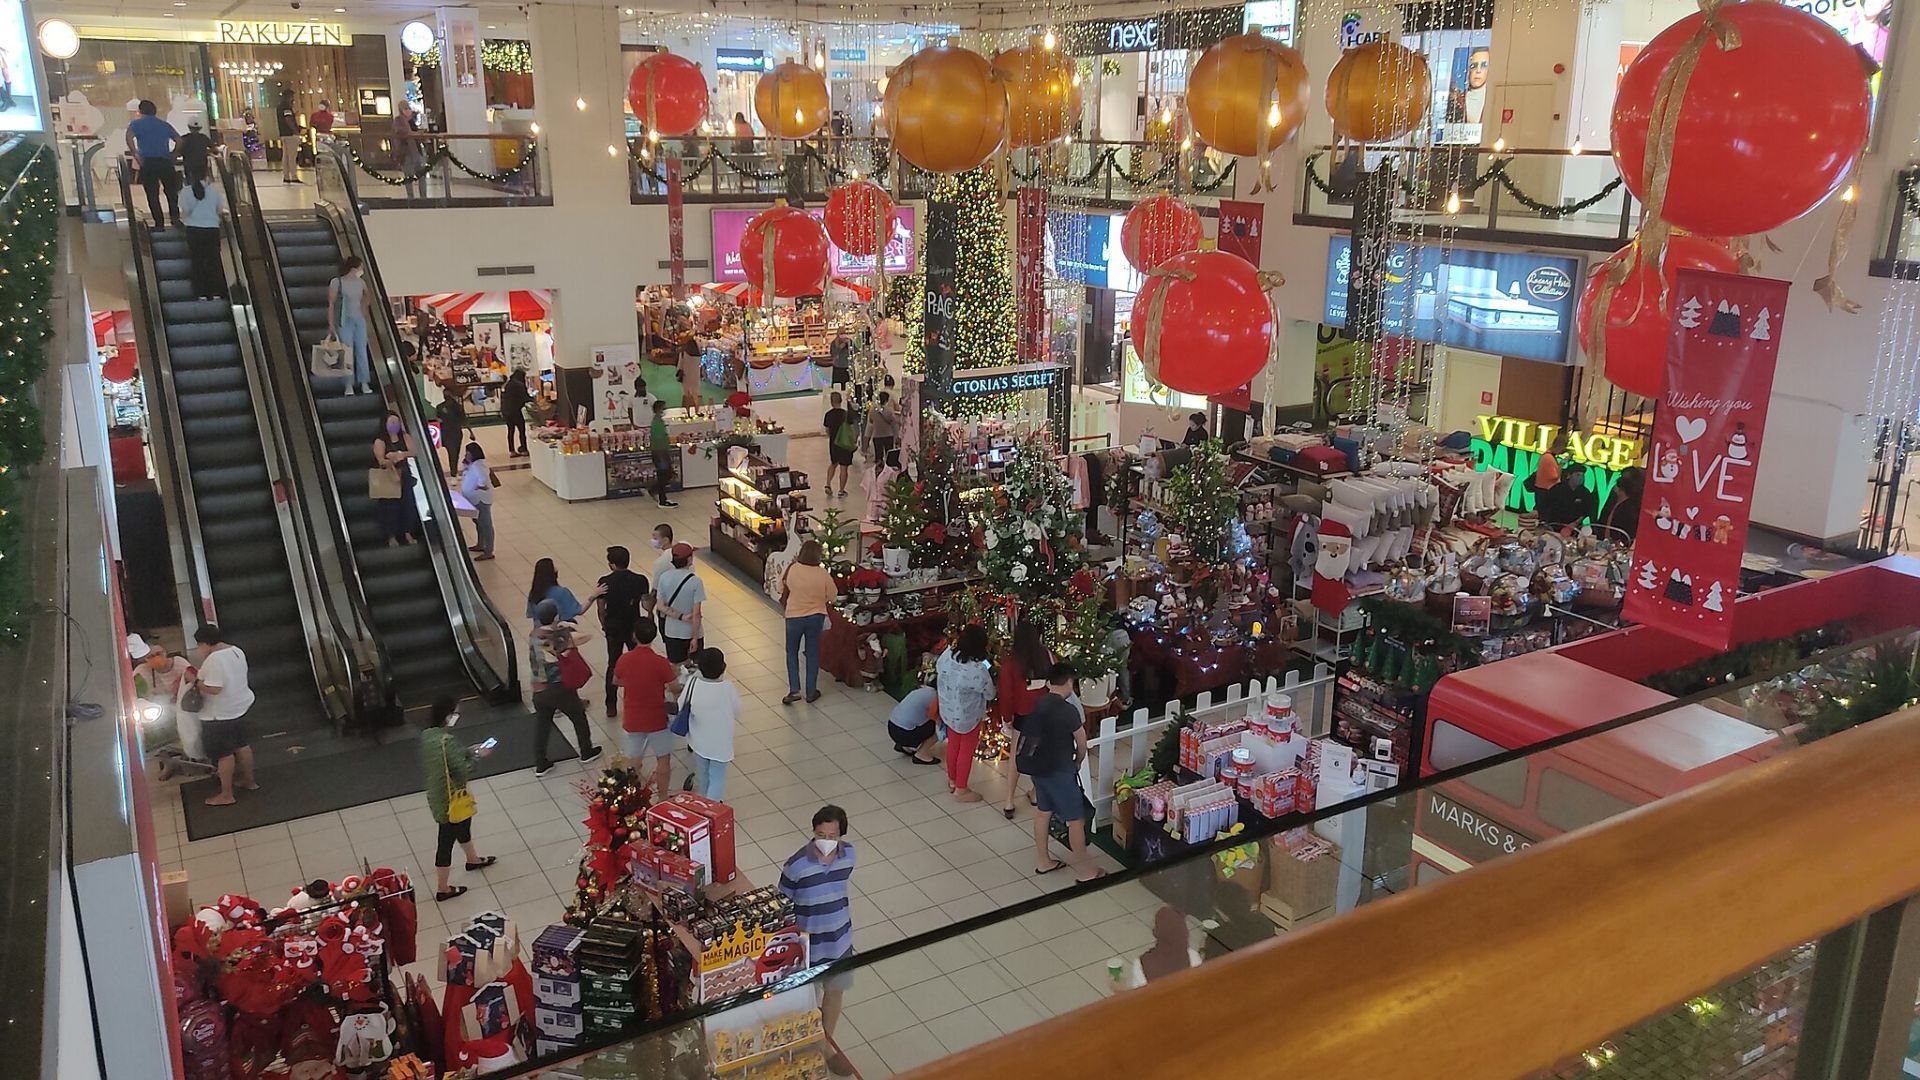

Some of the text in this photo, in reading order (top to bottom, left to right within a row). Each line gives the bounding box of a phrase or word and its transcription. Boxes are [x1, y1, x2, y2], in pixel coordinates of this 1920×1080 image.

[220, 22, 342, 46] RAKUZEN
[1110, 21, 1158, 49] next
[952, 372, 1055, 394] CTORIA'S SECRET
[1667, 390, 1753, 416] Wishing you
[1477, 415, 1636, 472] VILLAGE
[1431, 796, 1516, 853] MARKS &
[723, 936, 766, 961] MAGIC!
